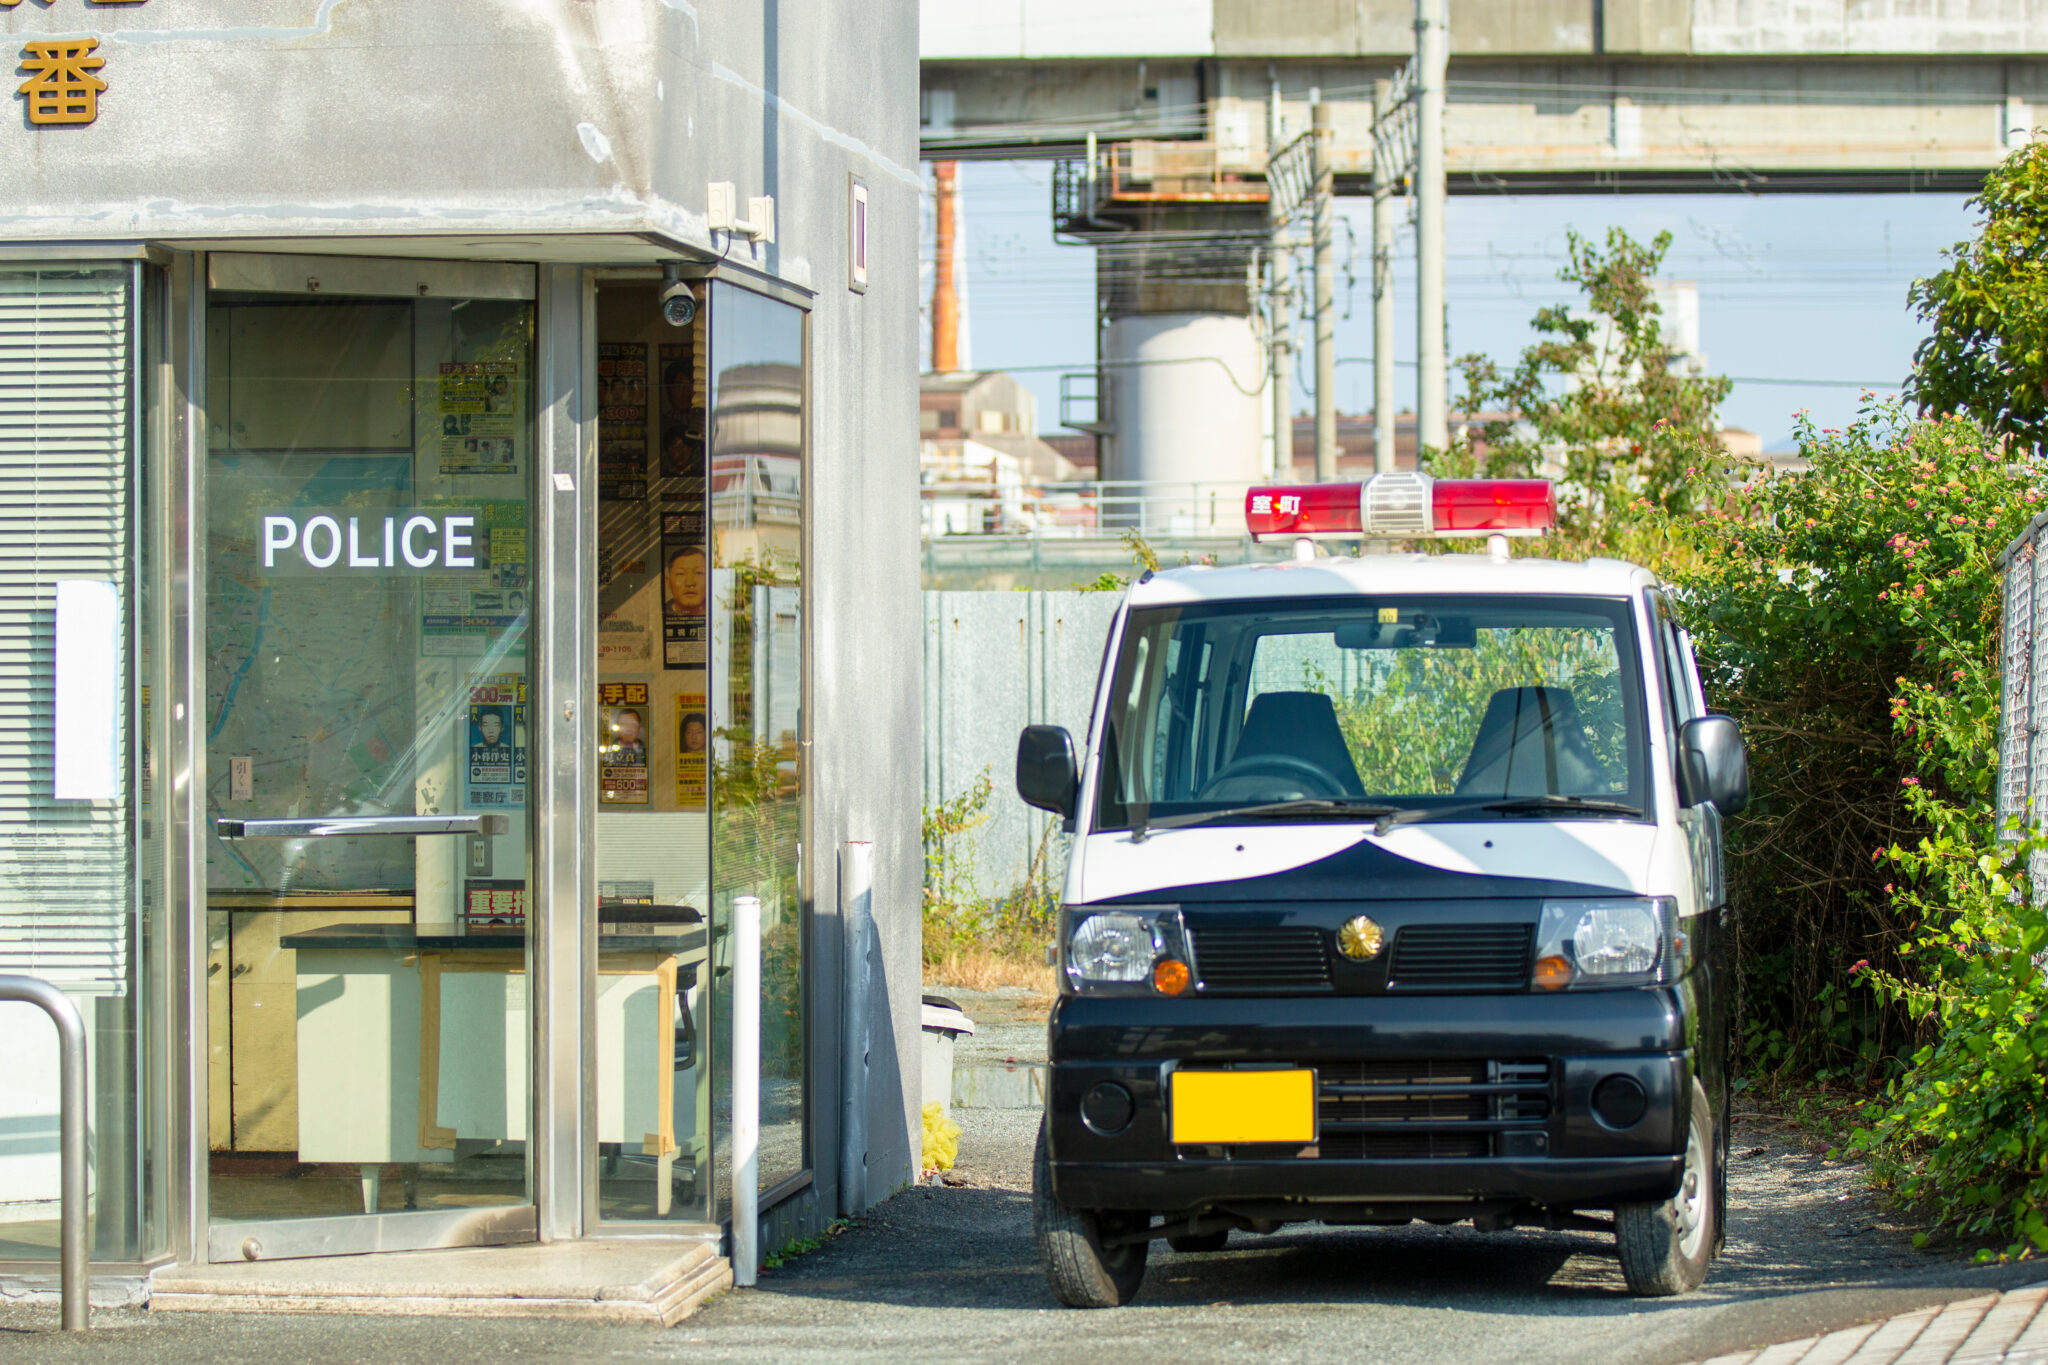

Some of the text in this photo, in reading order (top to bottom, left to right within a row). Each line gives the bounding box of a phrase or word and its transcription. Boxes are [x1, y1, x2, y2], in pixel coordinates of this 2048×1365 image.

[19, 37, 108, 124] 番
[1251, 495, 1301, 515] 室町
[264, 516, 475, 568] POLICE
